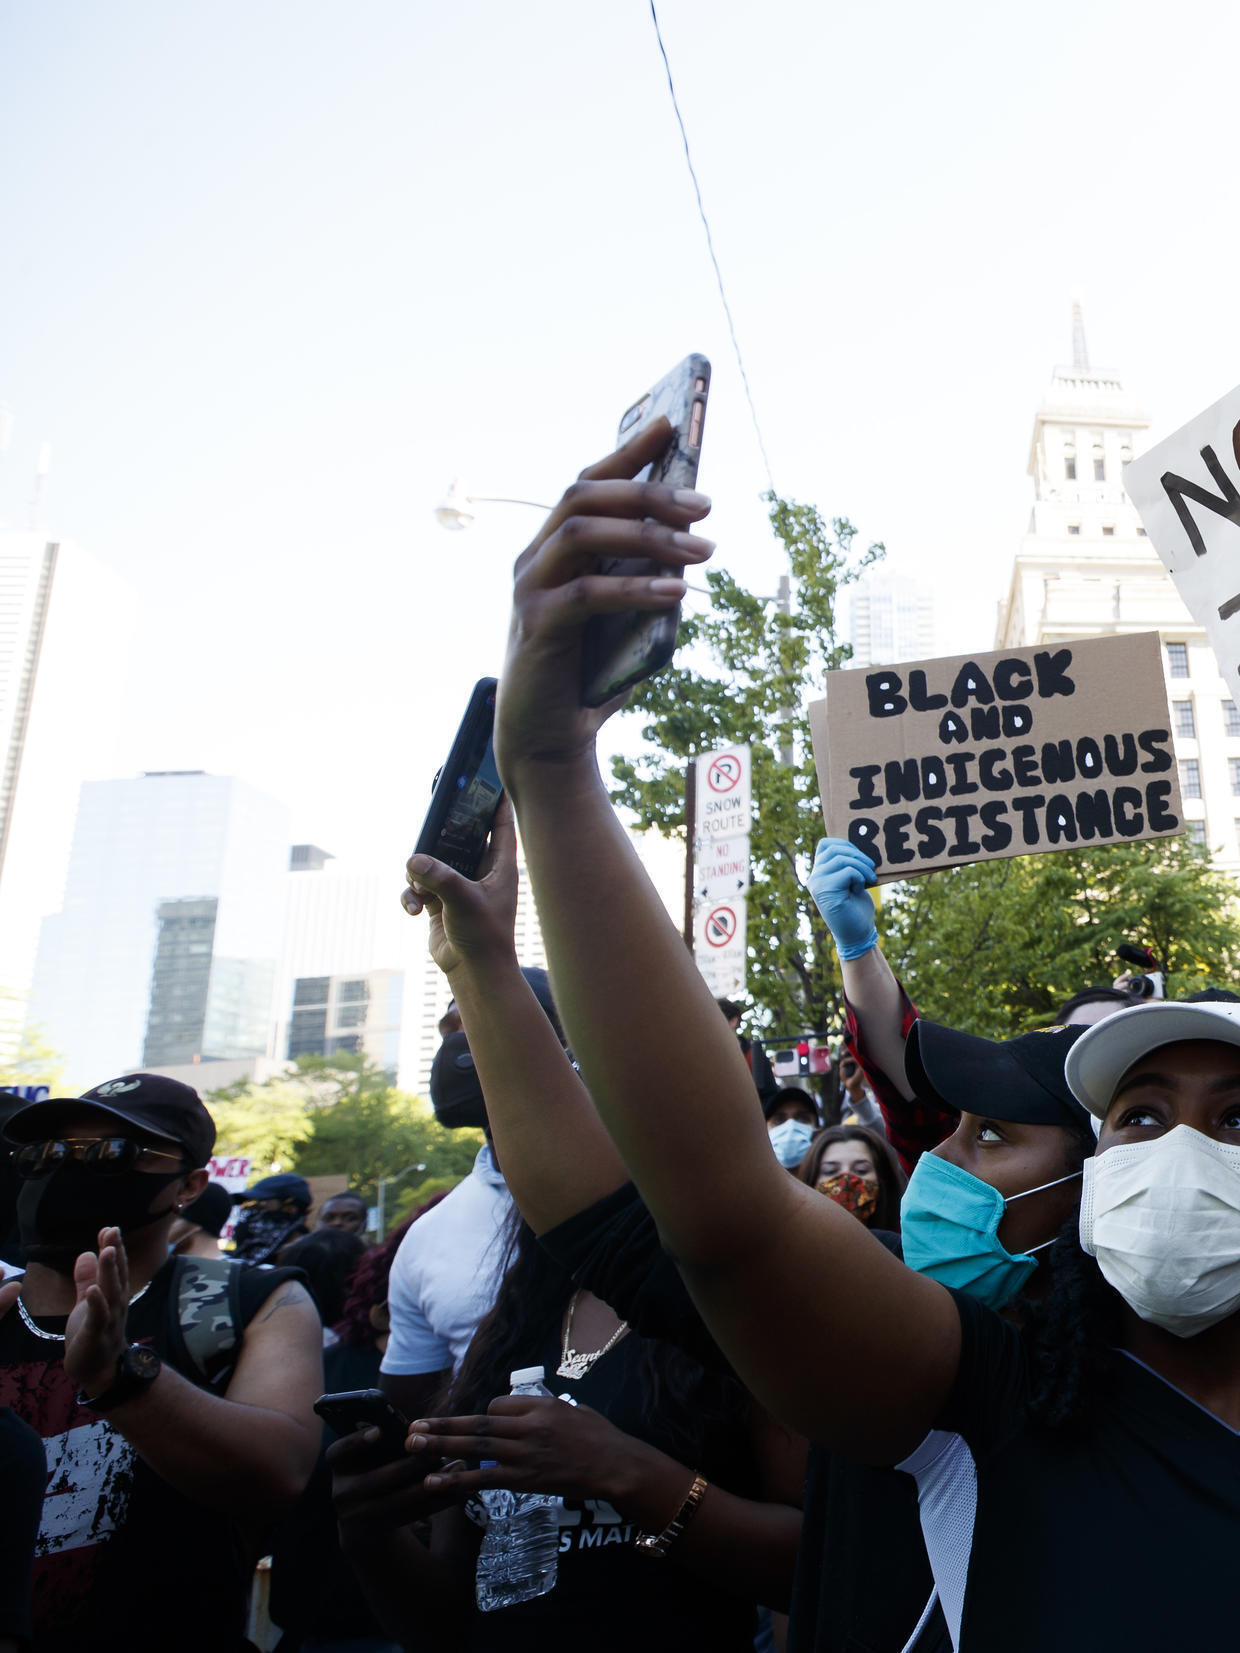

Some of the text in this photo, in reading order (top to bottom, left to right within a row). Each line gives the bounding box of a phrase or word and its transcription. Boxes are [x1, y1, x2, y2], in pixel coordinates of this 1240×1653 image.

[866, 649, 1075, 718] BLACK
[939, 704, 1033, 744] AND
[849, 729, 1172, 810] INDIGENOUS
[706, 796, 741, 815] SNOW
[703, 814, 744, 833] ROUTE
[848, 780, 1179, 868] RESISTANCE
[716, 844, 729, 858] NO
[700, 860, 745, 881] STANDING
[207, 1158, 249, 1177] OWER
[579, 1523, 635, 1549] MAT
